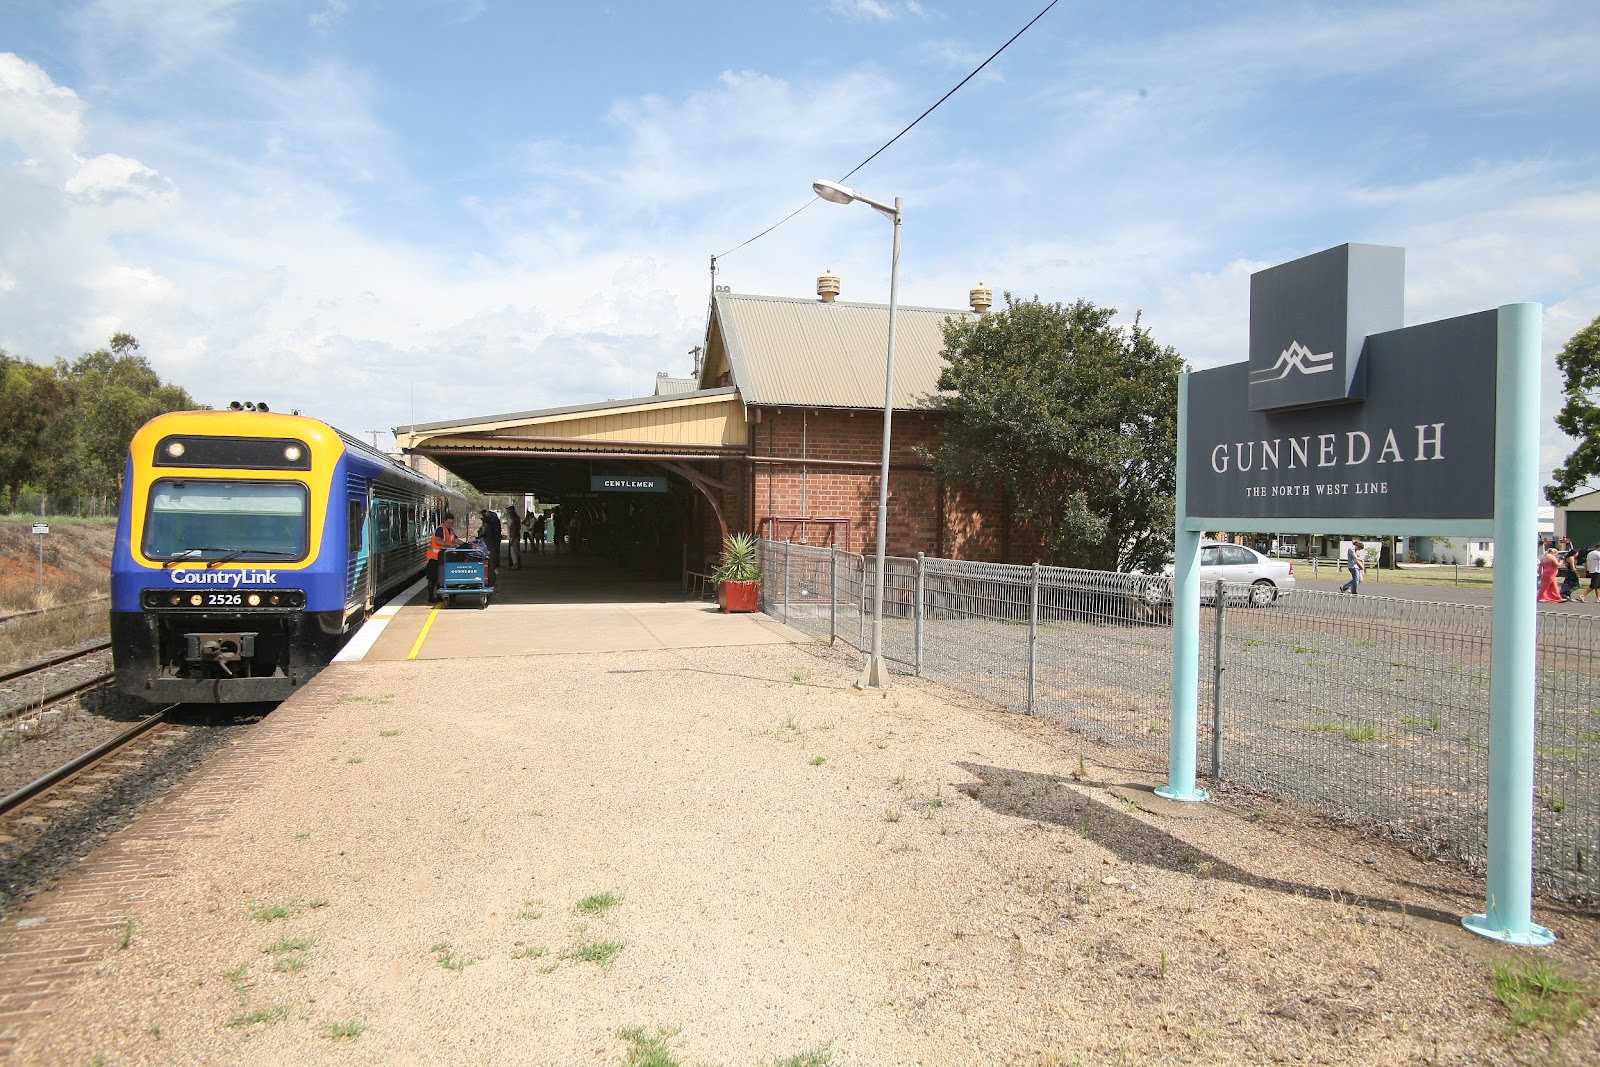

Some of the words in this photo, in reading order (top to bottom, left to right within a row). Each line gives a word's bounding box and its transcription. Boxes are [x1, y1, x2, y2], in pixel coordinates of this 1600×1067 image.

[1211, 423, 1445, 473] GUNNEDAH
[604, 480, 654, 488] GENTLEMEN
[1246, 487, 1267, 497] THE
[1271, 485, 1310, 497] NORTH
[1316, 483, 1349, 496] WEST
[1355, 482, 1388, 494] LINE
[171, 569, 277, 588] CountryLink
[208, 594, 242, 605] 2526
